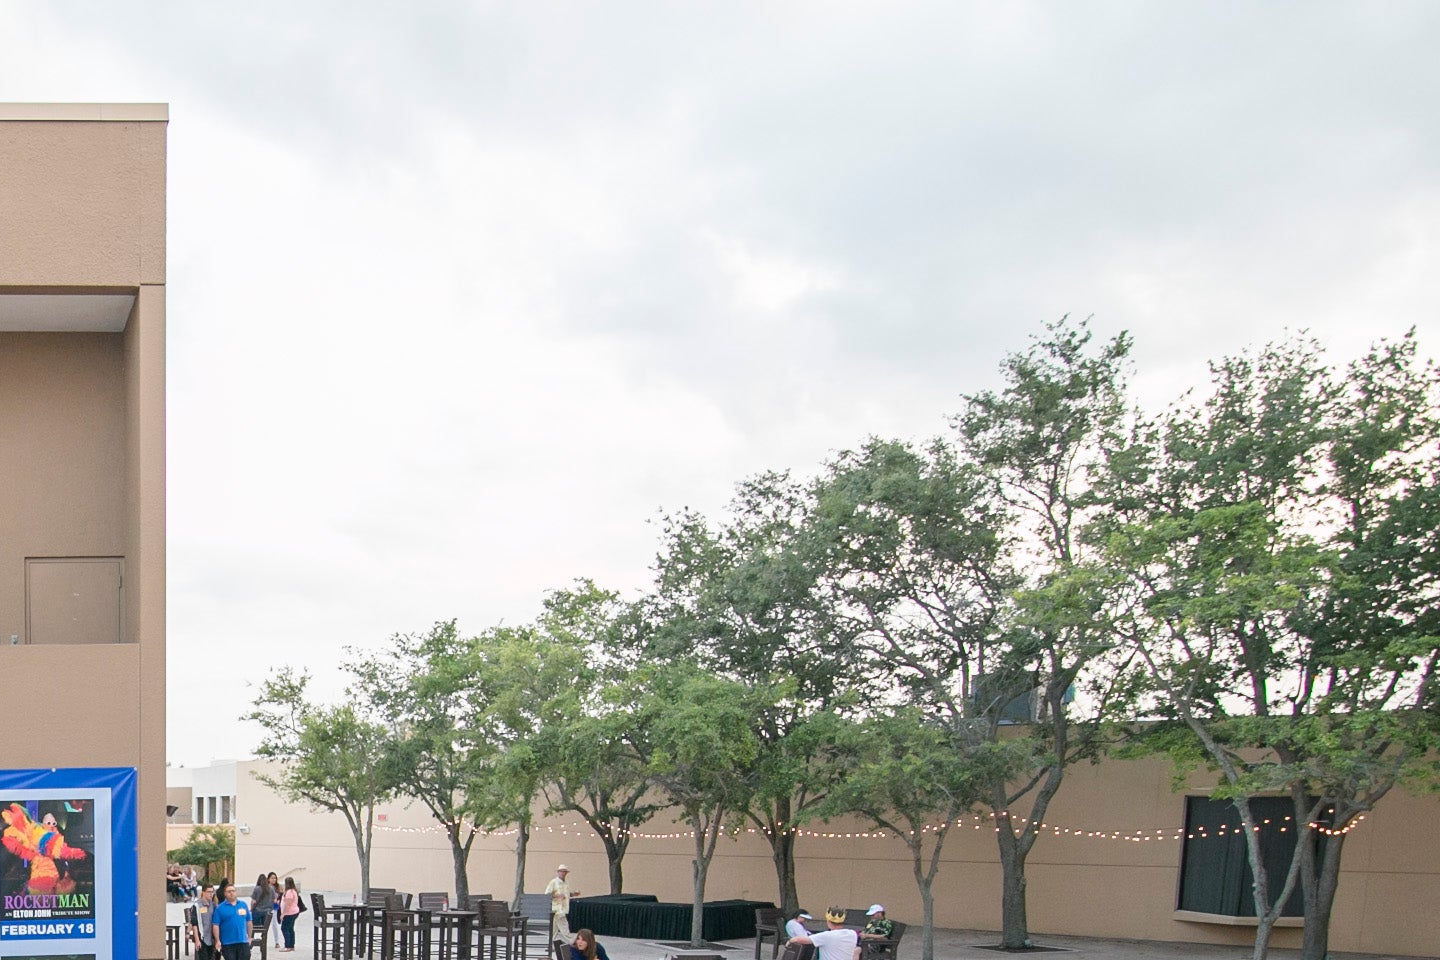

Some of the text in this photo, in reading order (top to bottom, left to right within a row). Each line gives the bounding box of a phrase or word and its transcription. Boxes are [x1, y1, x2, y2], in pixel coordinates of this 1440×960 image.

[4, 894, 89, 909] ROCKETMAN
[13, 910, 33, 918] ELTON
[34, 909, 51, 918] JOHN
[1, 924, 94, 935] FEBRUARY 18
